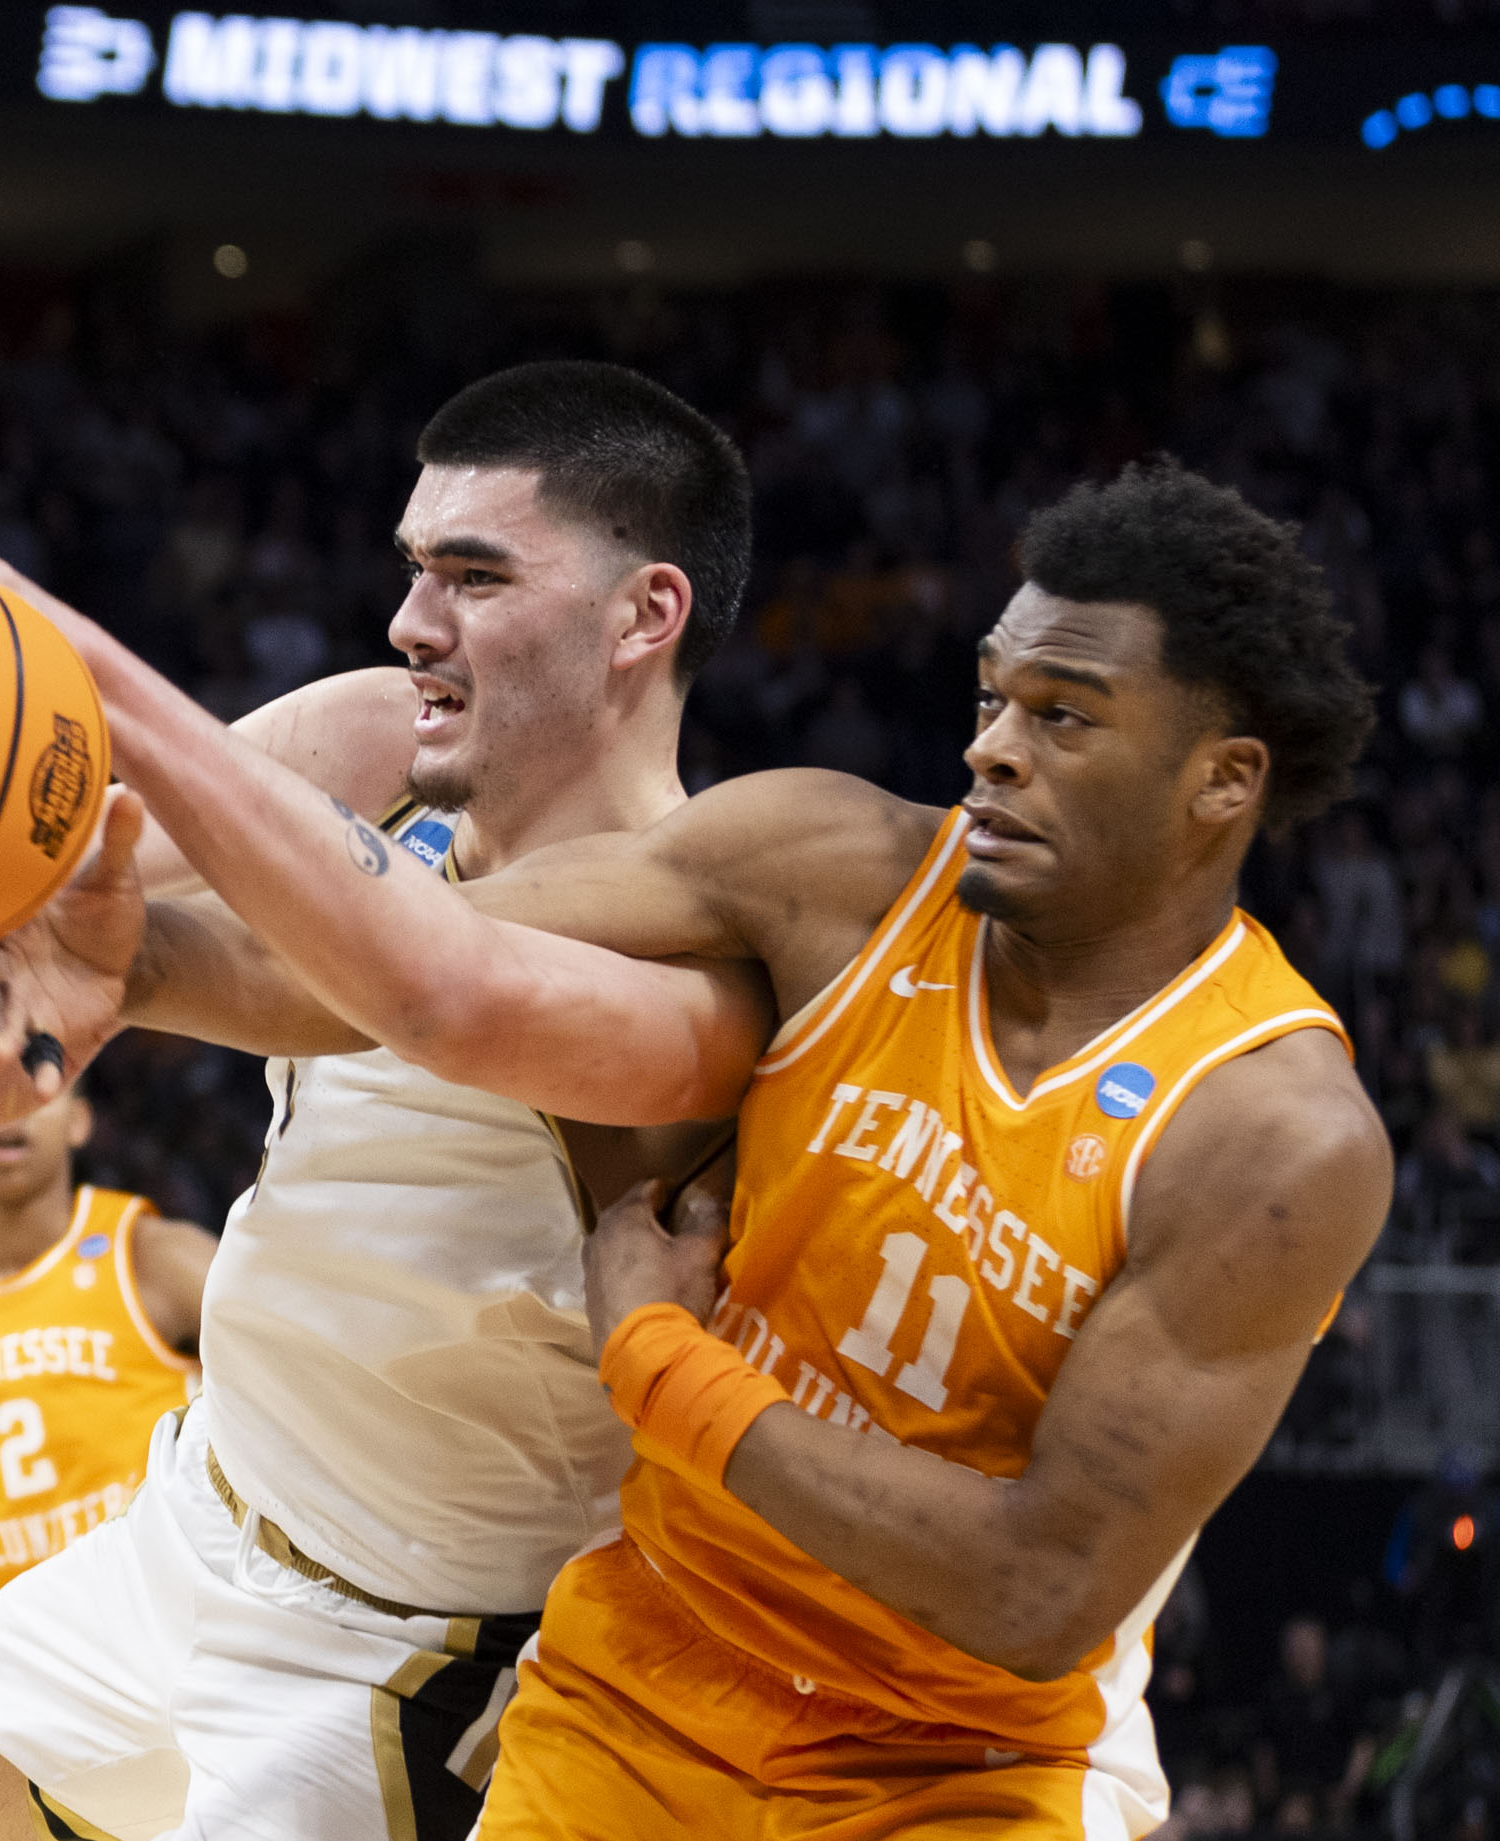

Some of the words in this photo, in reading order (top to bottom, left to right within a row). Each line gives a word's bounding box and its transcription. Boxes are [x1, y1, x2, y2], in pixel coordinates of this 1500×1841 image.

[162, 11, 624, 133] MIDWEST
[630, 43, 1142, 137] REGIONAL
[806, 1084, 1098, 1340] TENNESSEE
[837, 1232, 971, 1412] 11
